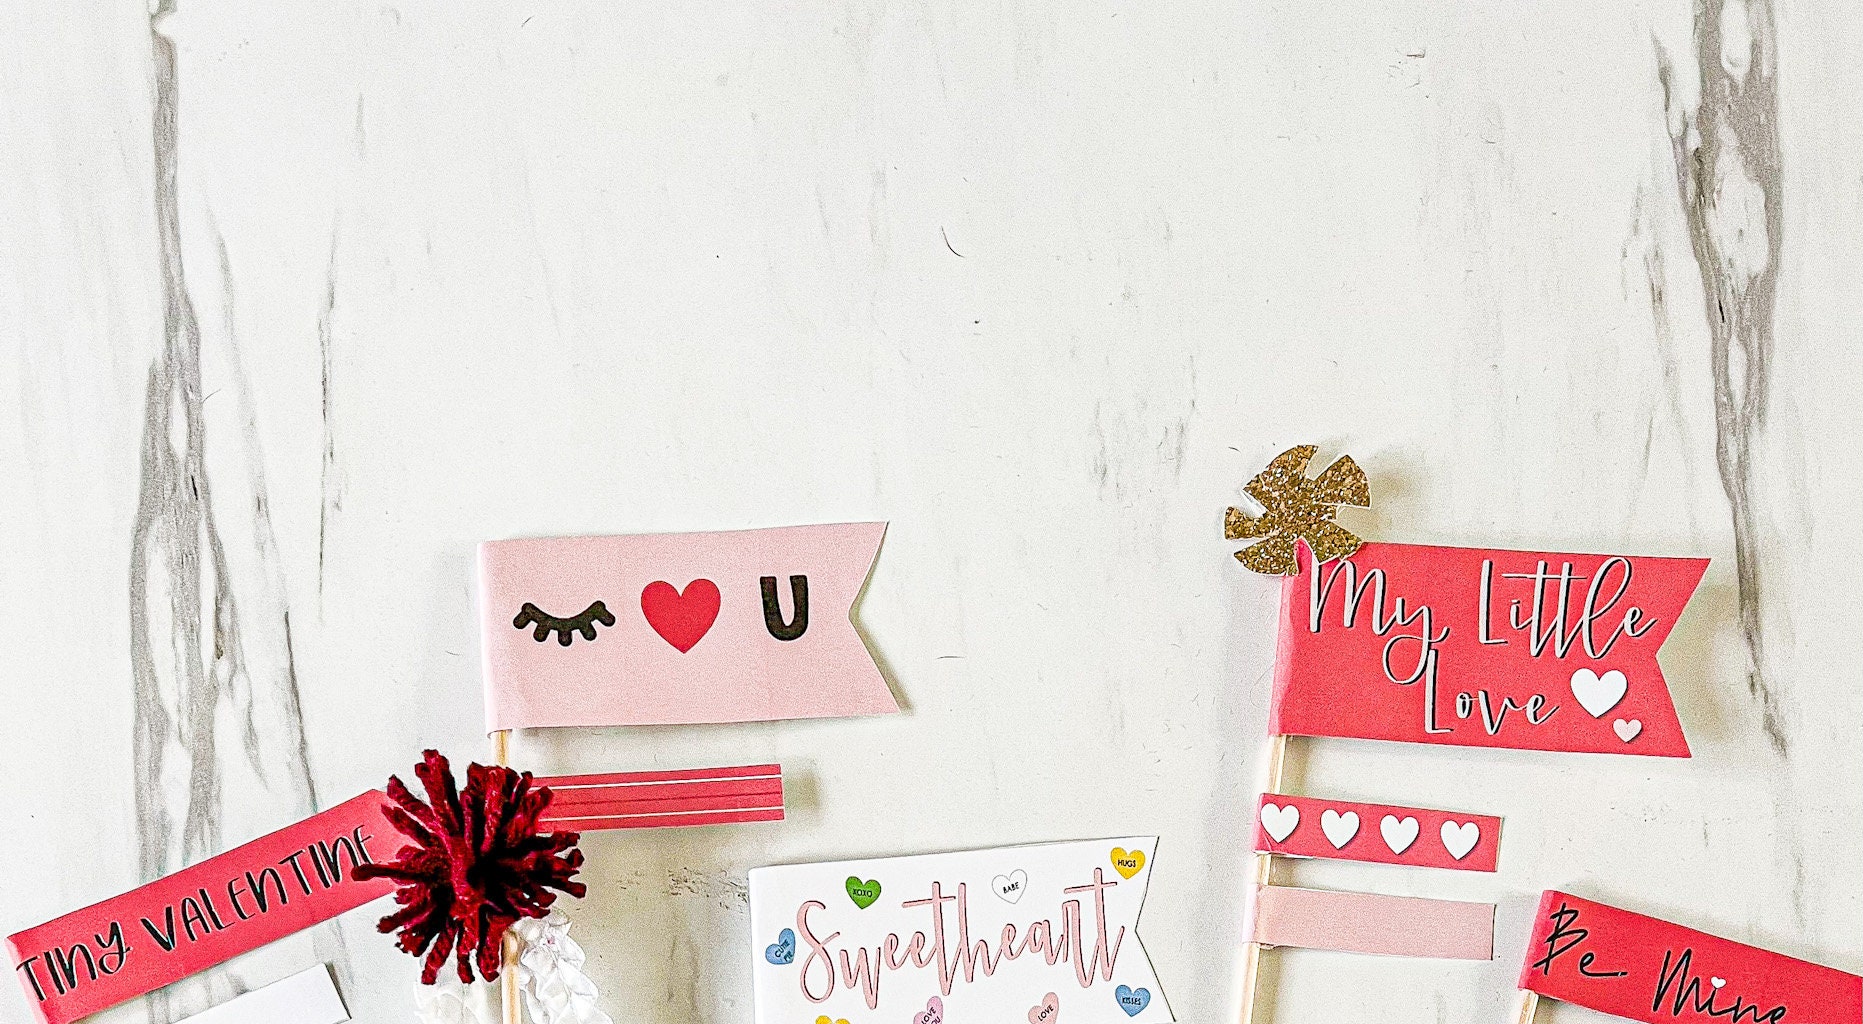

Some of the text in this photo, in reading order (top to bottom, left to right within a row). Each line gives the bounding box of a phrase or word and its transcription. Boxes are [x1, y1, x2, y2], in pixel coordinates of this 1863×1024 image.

[759, 574, 809, 641] U
[1309, 556, 1659, 685] My Little
[1425, 648, 1559, 735] Love
[1117, 858, 1136, 868] HUGS
[852, 888, 873, 898] XOXO
[1003, 881, 1020, 894] BABE
[775, 939, 790, 958] CUTE
[796, 867, 1125, 1010] Sweetheart
[1532, 902, 1628, 976] Be
[1037, 1004, 1053, 1021] LOVE
